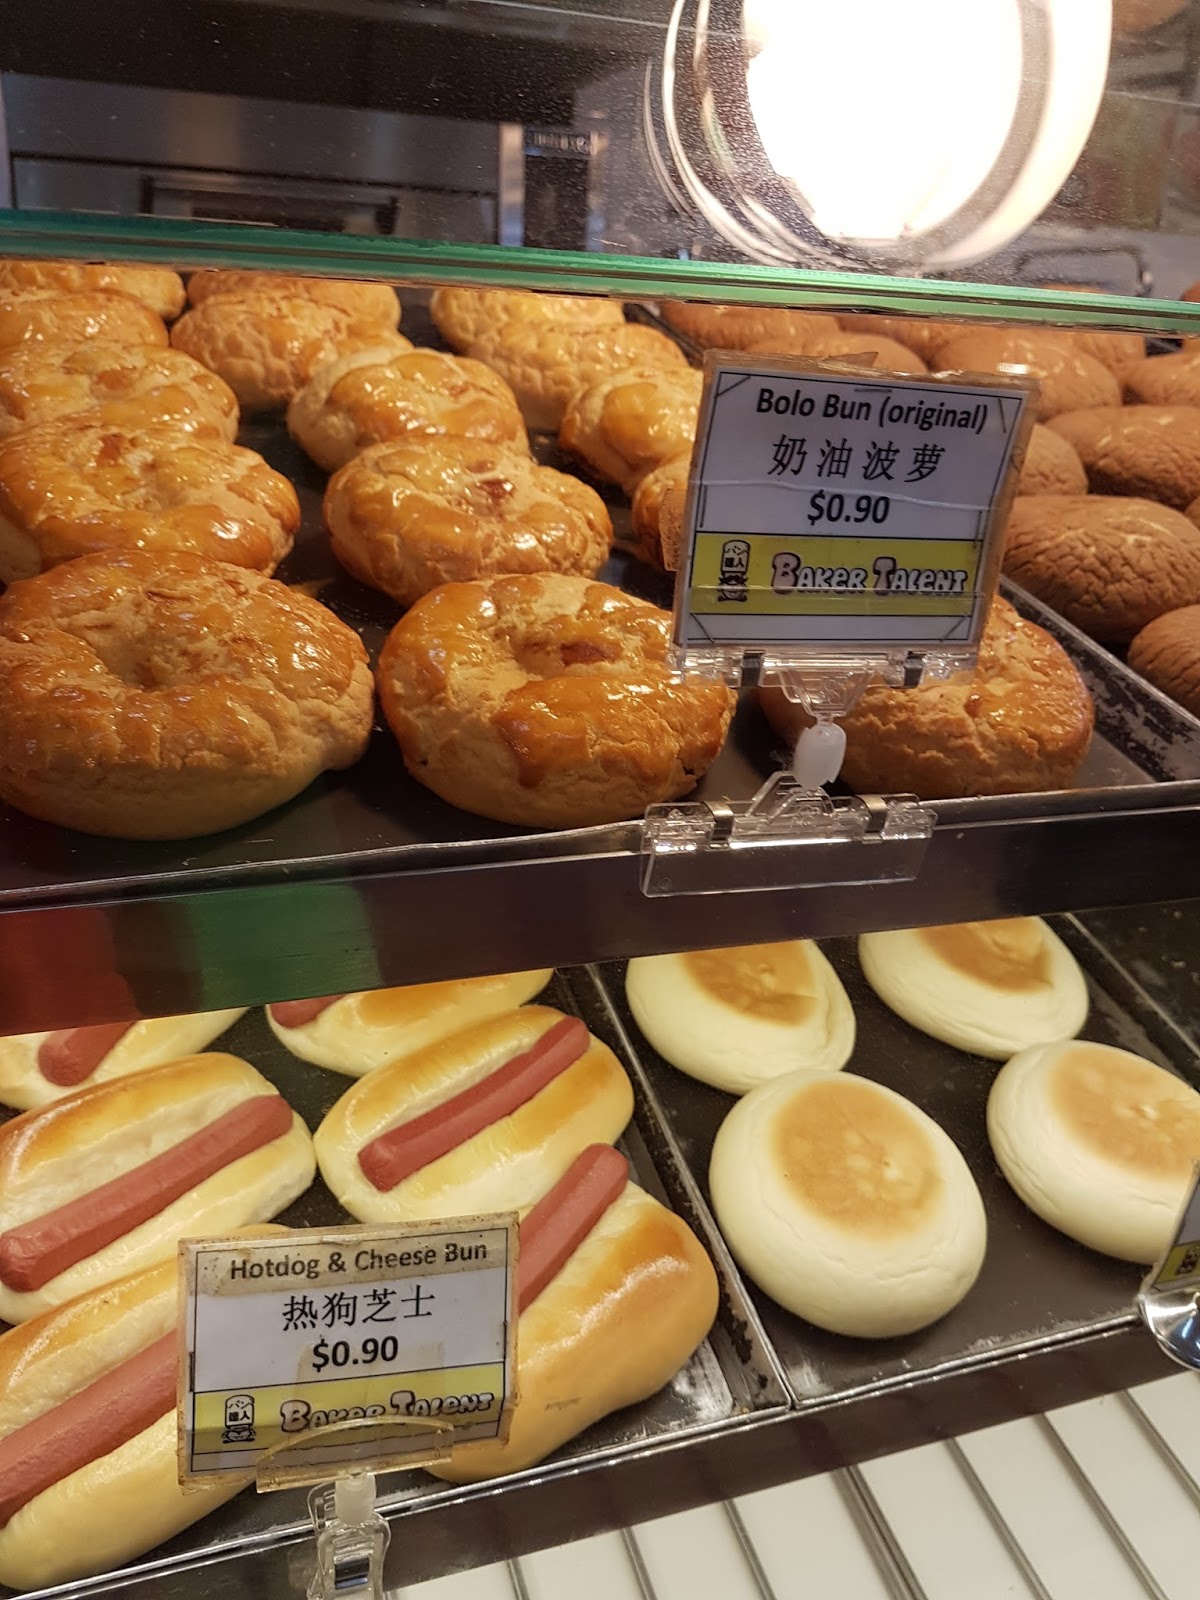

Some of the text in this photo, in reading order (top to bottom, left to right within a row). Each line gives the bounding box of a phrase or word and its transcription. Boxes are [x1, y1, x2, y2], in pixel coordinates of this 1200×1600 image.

[757, 388, 987, 434] Bolo Bun (original)
[768, 434, 946, 482] 奶油波萝
[807, 490, 890, 525] $0.90
[230, 1242, 487, 1280] Hotdog & Cheese Bun
[282, 1285, 435, 1331] 热狗芝士
[312, 1335, 399, 1372] $0.90
